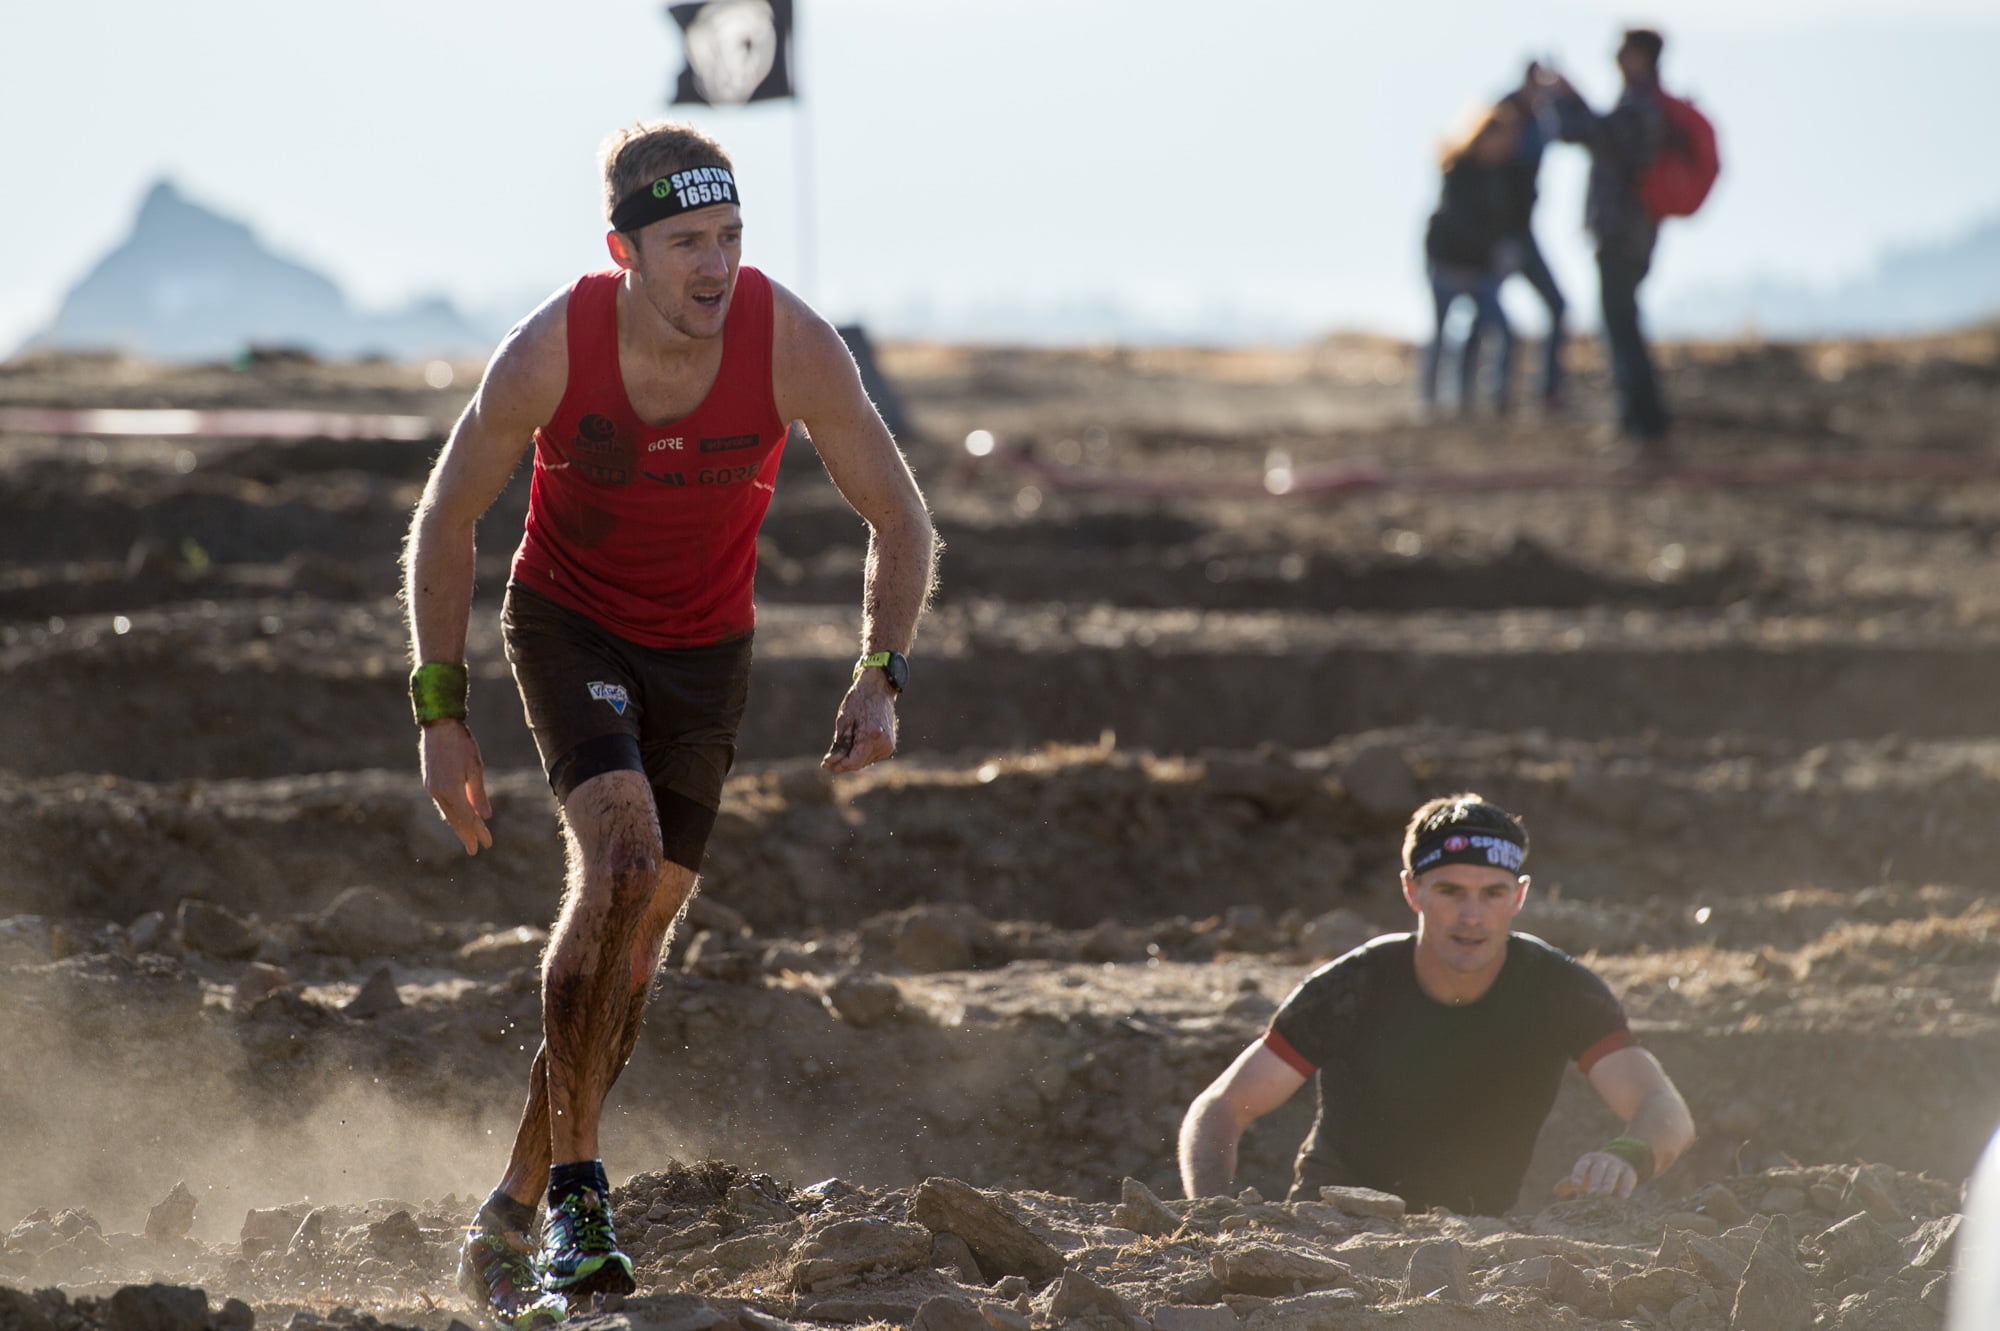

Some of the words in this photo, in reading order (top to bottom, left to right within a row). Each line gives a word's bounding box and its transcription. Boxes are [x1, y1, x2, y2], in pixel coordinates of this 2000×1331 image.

[676, 182, 732, 208] 16594
[647, 437, 684, 452] GORE
[699, 462, 760, 485] GORE
